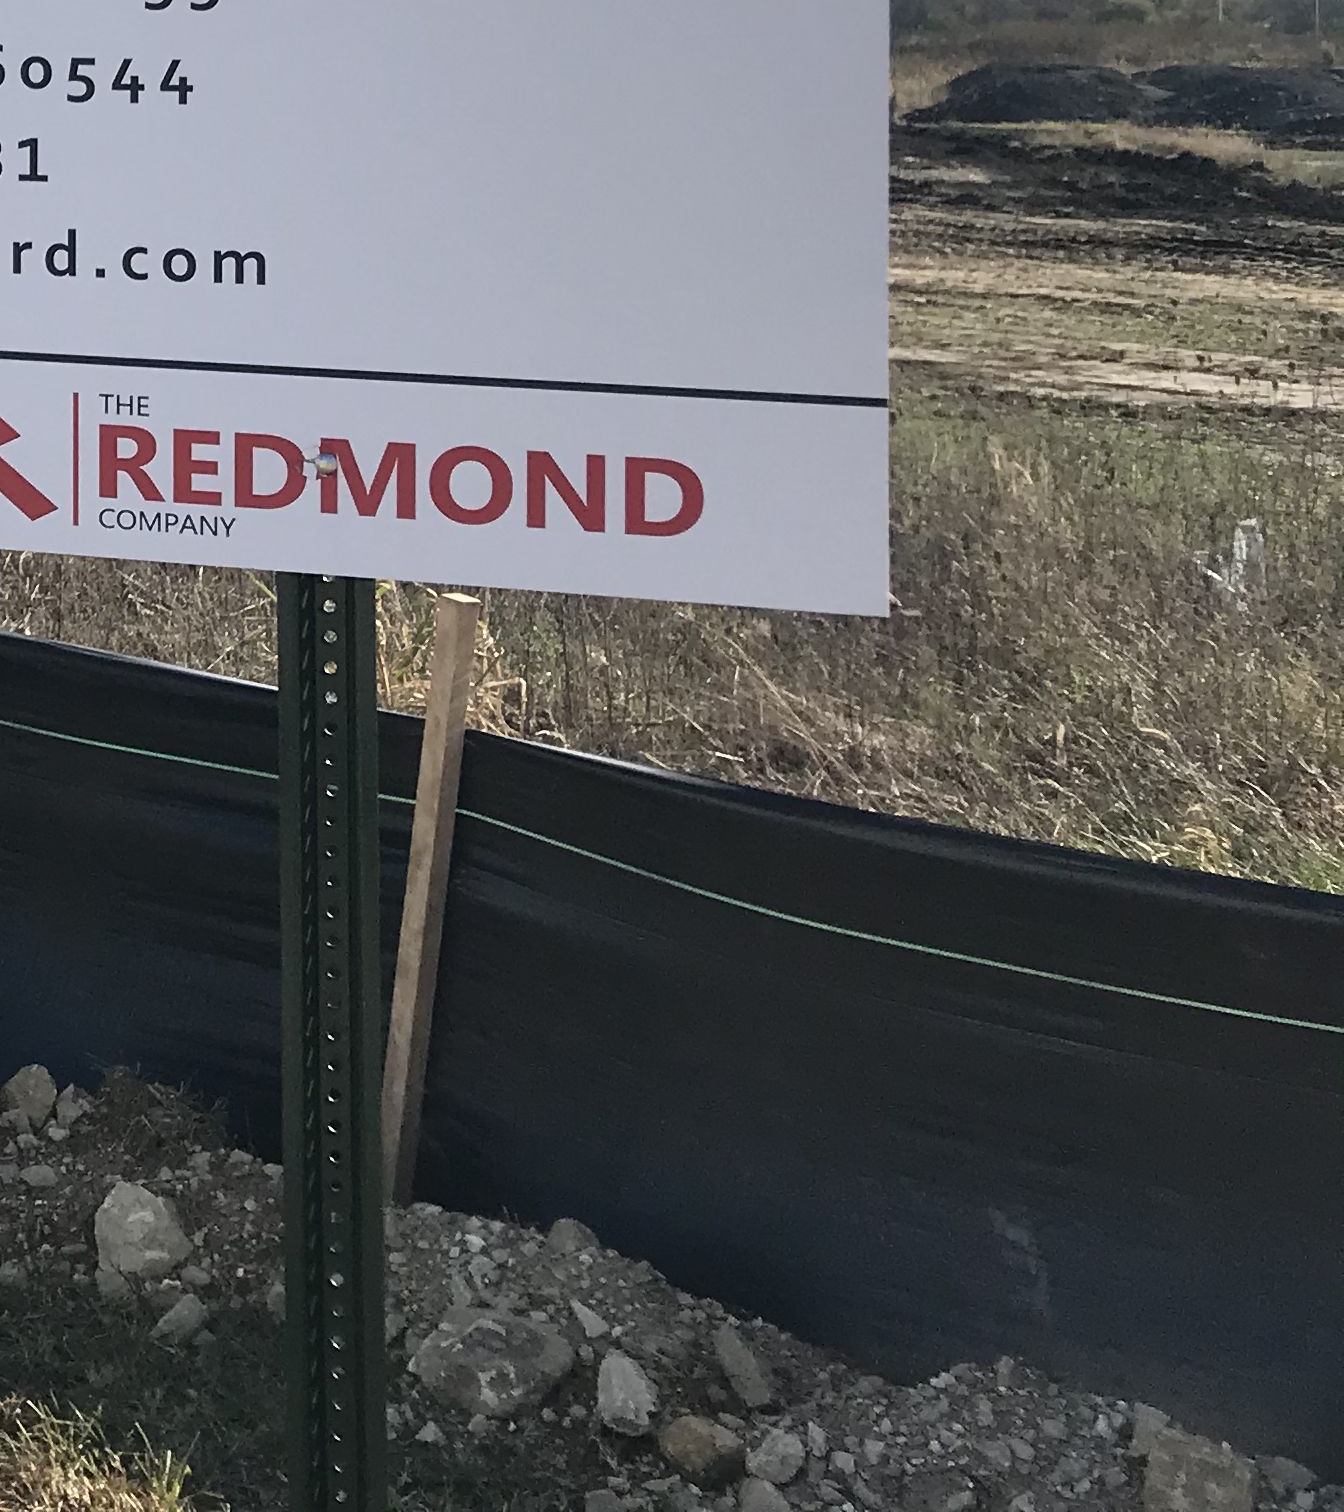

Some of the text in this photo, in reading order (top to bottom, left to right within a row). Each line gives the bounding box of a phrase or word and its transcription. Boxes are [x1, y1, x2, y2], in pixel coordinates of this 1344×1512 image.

[99, 394, 149, 416] THE
[100, 425, 702, 535] REDMOND
[99, 509, 235, 537] COMPANY
